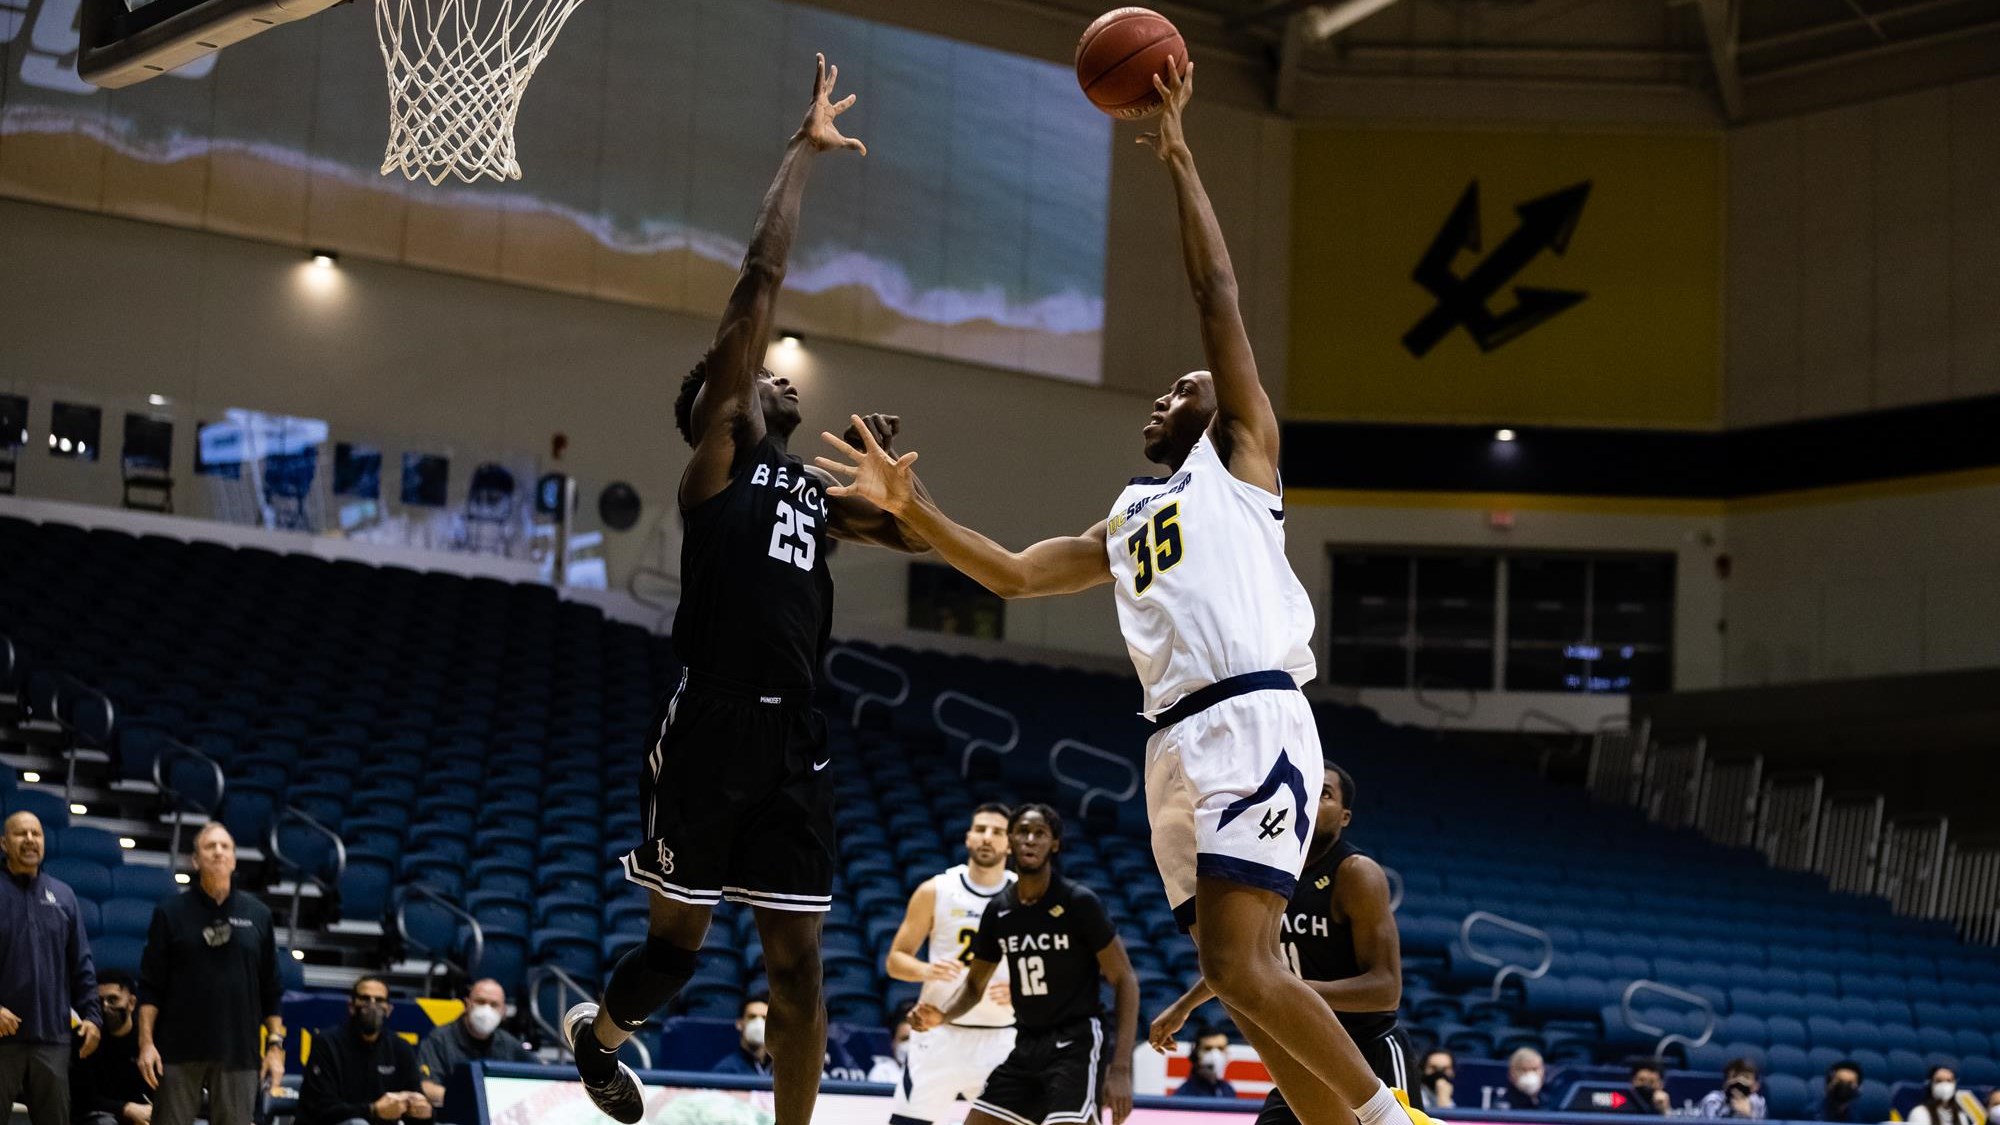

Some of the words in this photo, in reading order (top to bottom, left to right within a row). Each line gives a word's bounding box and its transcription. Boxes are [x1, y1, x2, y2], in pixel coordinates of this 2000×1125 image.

[768, 499, 817, 572] 25
[1126, 500, 1185, 598] 35
[998, 933, 1070, 955] BEACH
[1280, 912, 1329, 938] ACH
[1017, 955, 1049, 997] 12
